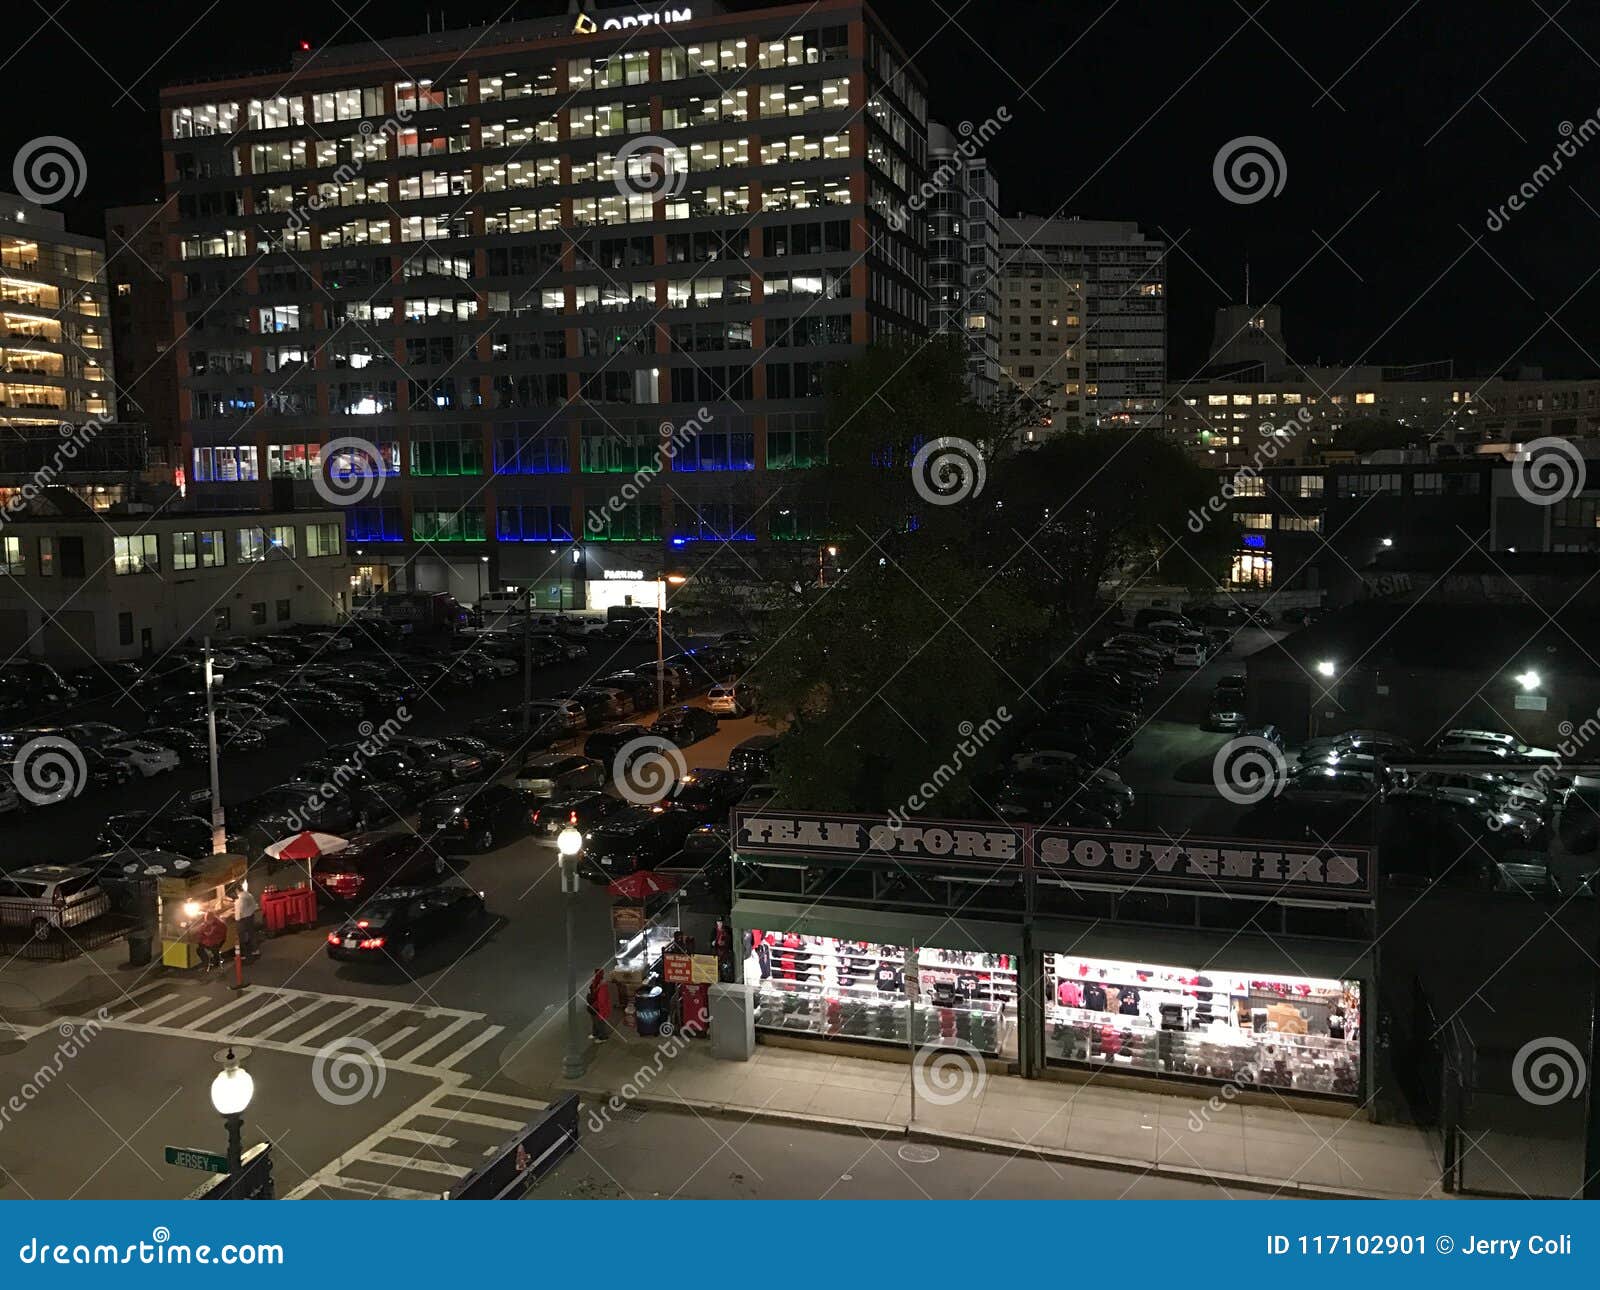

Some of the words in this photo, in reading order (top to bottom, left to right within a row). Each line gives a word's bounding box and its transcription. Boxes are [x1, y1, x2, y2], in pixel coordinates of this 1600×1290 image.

[743, 817, 860, 848] TEAM
[869, 825, 1016, 859] STORE
[1040, 837, 1359, 884] SOUVENIRS
[174, 1151, 209, 1169] JERSEY
